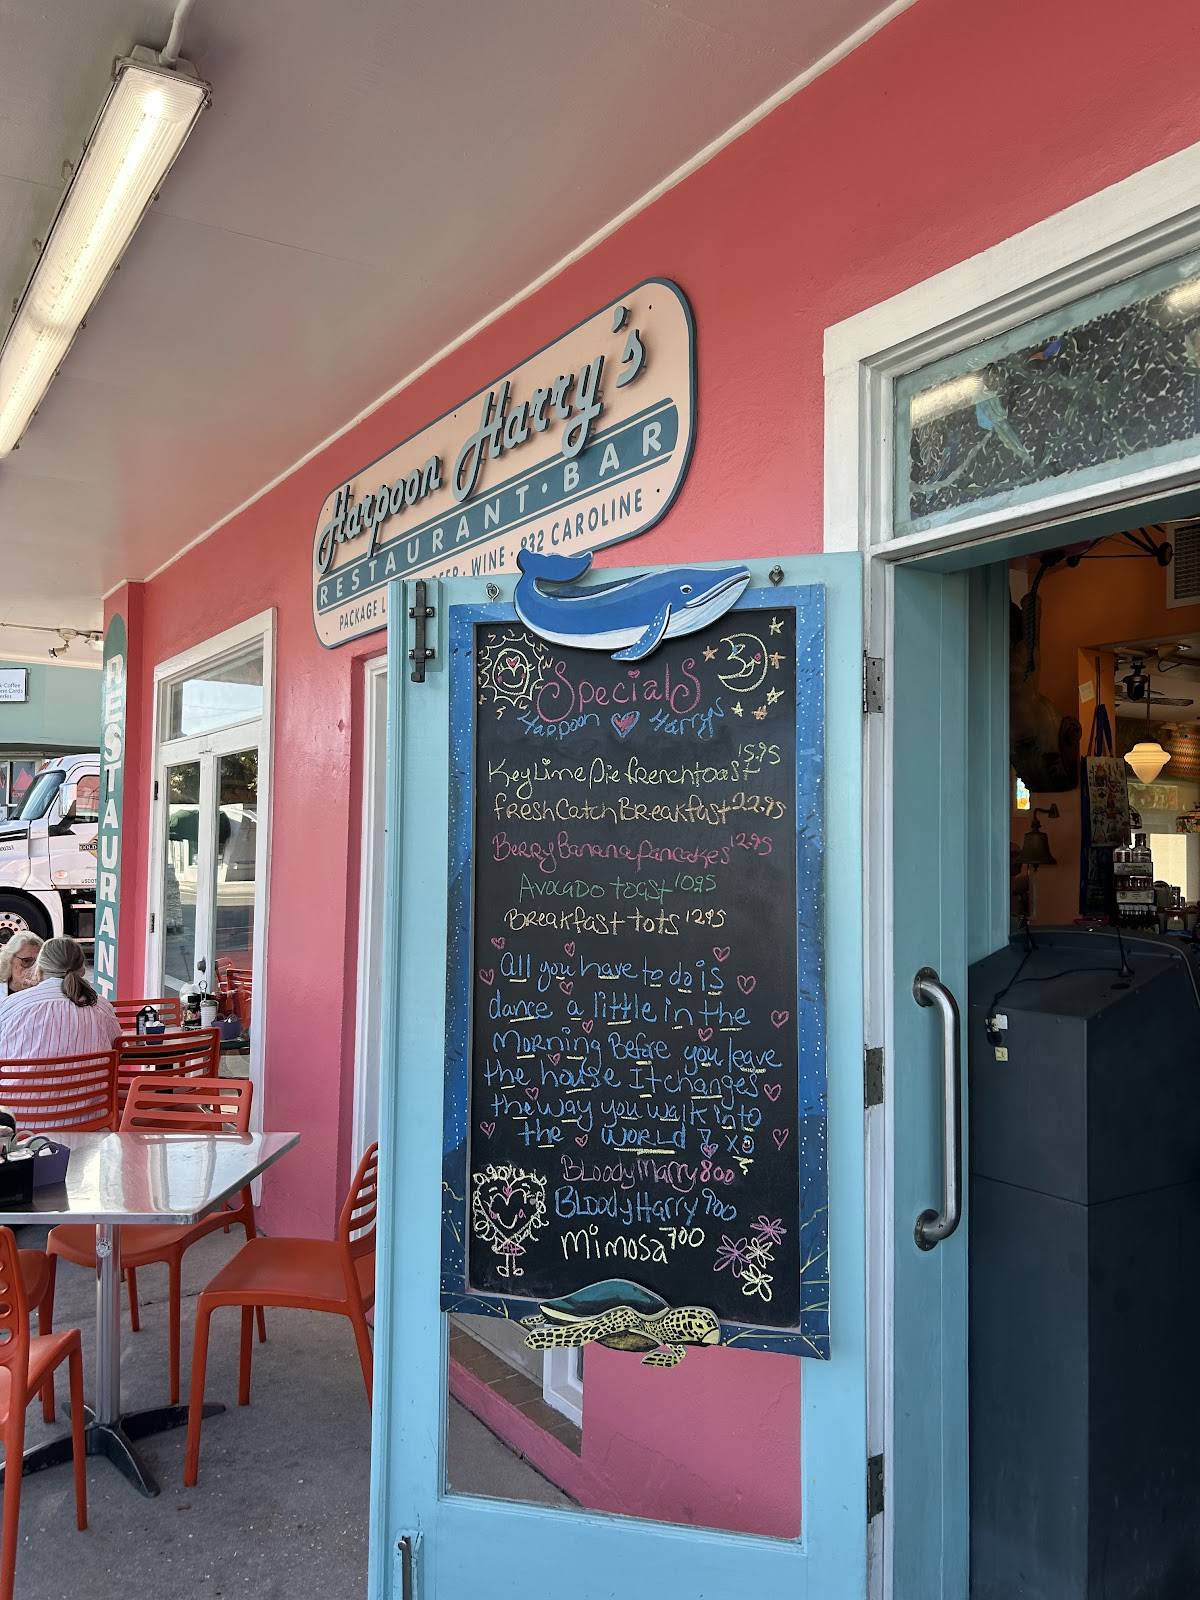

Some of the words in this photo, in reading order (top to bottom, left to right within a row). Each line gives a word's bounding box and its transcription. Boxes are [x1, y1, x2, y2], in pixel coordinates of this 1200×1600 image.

[318, 456, 442, 573] Harpoon
[456, 306, 646, 501] Harry's
[319, 485, 530, 607] RESTAURANT
[563, 421, 662, 491] BAR
[339, 599, 378, 631] PACKAGE
[471, 546, 504, 576] WINE
[551, 488, 643, 545] CAROLINE
[97, 653, 123, 999] RESTAURANT
[538, 961, 576, 992] you
[580, 955, 638, 979] have
[642, 956, 663, 986] to
[670, 961, 693, 987] do
[695, 959, 725, 991] is
[489, 989, 553, 1020] dance
[567, 1000, 585, 1016] a
[594, 991, 657, 1022] little
[664, 997, 693, 1025] in
[698, 1000, 751, 1026] the
[483, 1059, 531, 1086] the
[684, 1045, 724, 1075] you
[729, 1037, 783, 1072] leave
[517, 1119, 565, 1147] the
[536, 1099, 593, 1132] way
[601, 1099, 643, 1128] you
[647, 1100, 707, 1126] walk
